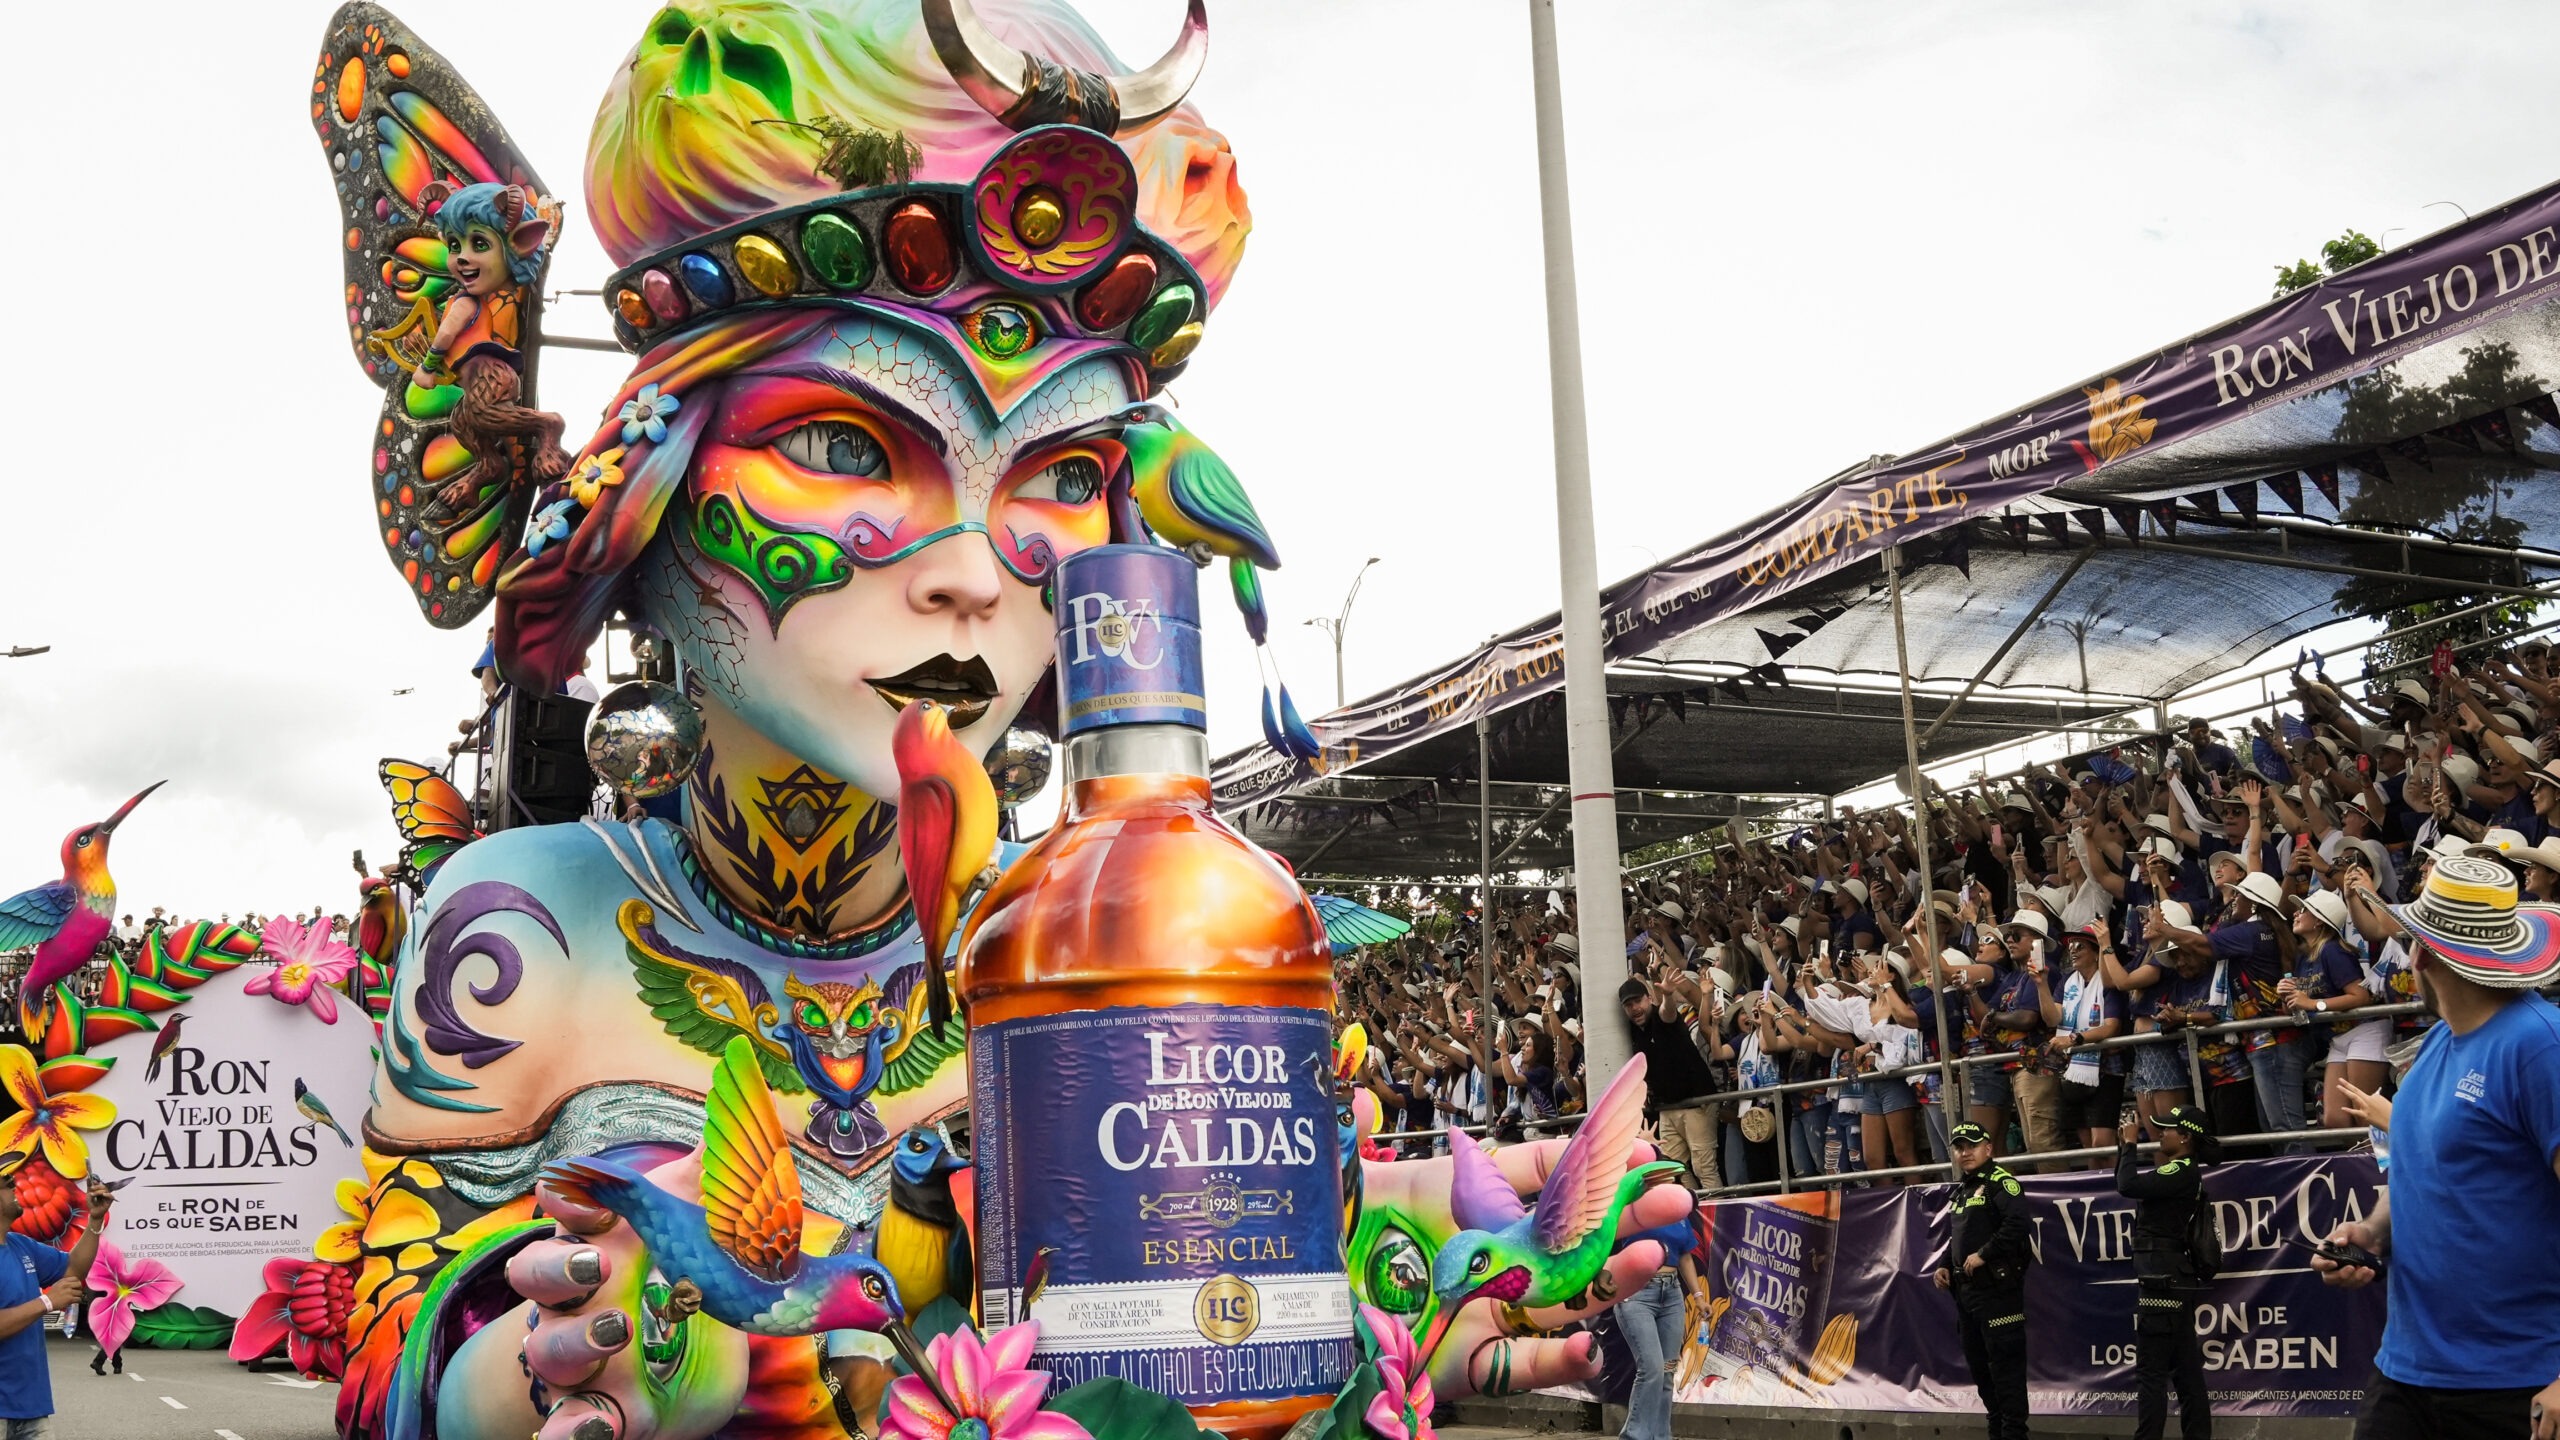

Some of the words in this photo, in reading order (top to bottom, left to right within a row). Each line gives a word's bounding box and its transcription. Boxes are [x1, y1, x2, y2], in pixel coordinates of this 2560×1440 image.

[2208, 326, 2314, 408] RON
[2321, 264, 2478, 356] VIEJO
[2487, 226, 2560, 298] DE
[2255, 394, 2276, 409] EXCESO
[2276, 392, 2284, 400] DE
[2285, 381, 2309, 398] ALCOHOL
[2310, 378, 2318, 387] ES
[2318, 365, 2353, 384] PERJUDICIAL
[2433, 328, 2440, 338] EL
[2442, 316, 2472, 335] EXPENDIO
[2473, 312, 2482, 321] DE
[2482, 302, 2508, 319] BEBIDAS
[2509, 282, 2558, 308] EMBRIAGANTES
[1415, 659, 1508, 722] MEJOR
[1614, 613, 1639, 637] EL
[1643, 590, 1685, 624] QUE
[1688, 572, 1713, 604] SE
[1109, 696, 1127, 705] LOS
[1130, 696, 1150, 704] QUE
[1153, 695, 1183, 703] SABEN
[1224, 784, 1238, 798] LOS
[1240, 777, 1256, 793] QUE
[1256, 760, 1298, 789] SABEN
[1026, 1023, 1048, 1035] BLANCO
[1048, 1020, 1092, 1031] COLOMBIANO.
[1094, 1018, 1113, 1027] CADA
[1114, 1017, 1147, 1026] BOTELLA
[1148, 1015, 1186, 1024] CONTIENE
[1186, 1015, 1200, 1023] ESE
[1202, 1014, 1229, 1023] LEGADO
[1230, 1014, 1242, 1023] DEL
[1243, 1015, 1270, 1023] CREADOR
[1279, 1016, 1302, 1025] NUESTRA
[166, 1047, 270, 1096] RON
[1144, 1032, 1288, 1085] LICOR
[156, 1099, 232, 1126] VIEJO
[242, 1105, 272, 1124] DE
[1148, 1094, 1173, 1111] DE
[1174, 1088, 1218, 1110] RON
[1218, 1087, 1270, 1109] VIEJO
[1272, 1093, 1292, 1108] DE
[106, 1119, 318, 1171] CALDAS
[1097, 1101, 1317, 1170] CALDAS
[1202, 1172, 1242, 1184] DESDE
[158, 1202, 176, 1212] EL
[182, 1198, 239, 1215] RON
[246, 1200, 265, 1210] DE
[1209, 1198, 1238, 1212] 1928
[125, 1218, 160, 1230] LOS
[167, 1218, 204, 1230] QUE
[209, 1214, 298, 1232] SABEN
[1742, 1207, 1802, 1261] LICOR
[2210, 1196, 2282, 1252] DE
[1142, 1236, 1294, 1264] ESENCIAL
[1740, 1247, 1750, 1261] DE
[1750, 1247, 1768, 1266] RON
[1767, 1252, 1790, 1274] VIEJO
[1790, 1266, 1800, 1278] DE
[1722, 1248, 1808, 1318] CALDAS
[1068, 1312, 1079, 1321] DE
[1081, 1310, 1122, 1320] NUESTRA
[1151, 1308, 1164, 1316] DE
[1071, 1302, 1090, 1312] CON
[1092, 1301, 1117, 1310] AGUA
[1120, 1299, 1162, 1309] POTABLE
[1208, 1296, 1248, 1323] ILC
[1276, 1311, 1291, 1319] 2200
[2195, 1302, 2249, 1337] ON
[2259, 1306, 2287, 1325] DE
[1724, 1335, 1780, 1373] ESENCIAL
[2092, 1344, 2137, 1366] LOS
[2203, 1336, 2337, 1370] SABEN
[1120, 1352, 1198, 1396] ALCOHOL
[1204, 1350, 1224, 1393] ES
[1227, 1344, 1314, 1392] PERJUDICIAL
[1318, 1343, 1340, 1384] PARA
[2229, 1390, 2289, 1400] EMBRIAGANTES
[2290, 1390, 2297, 1400] A
[2299, 1390, 2338, 1400] MENORES
[2339, 1390, 2351, 1400] DE
